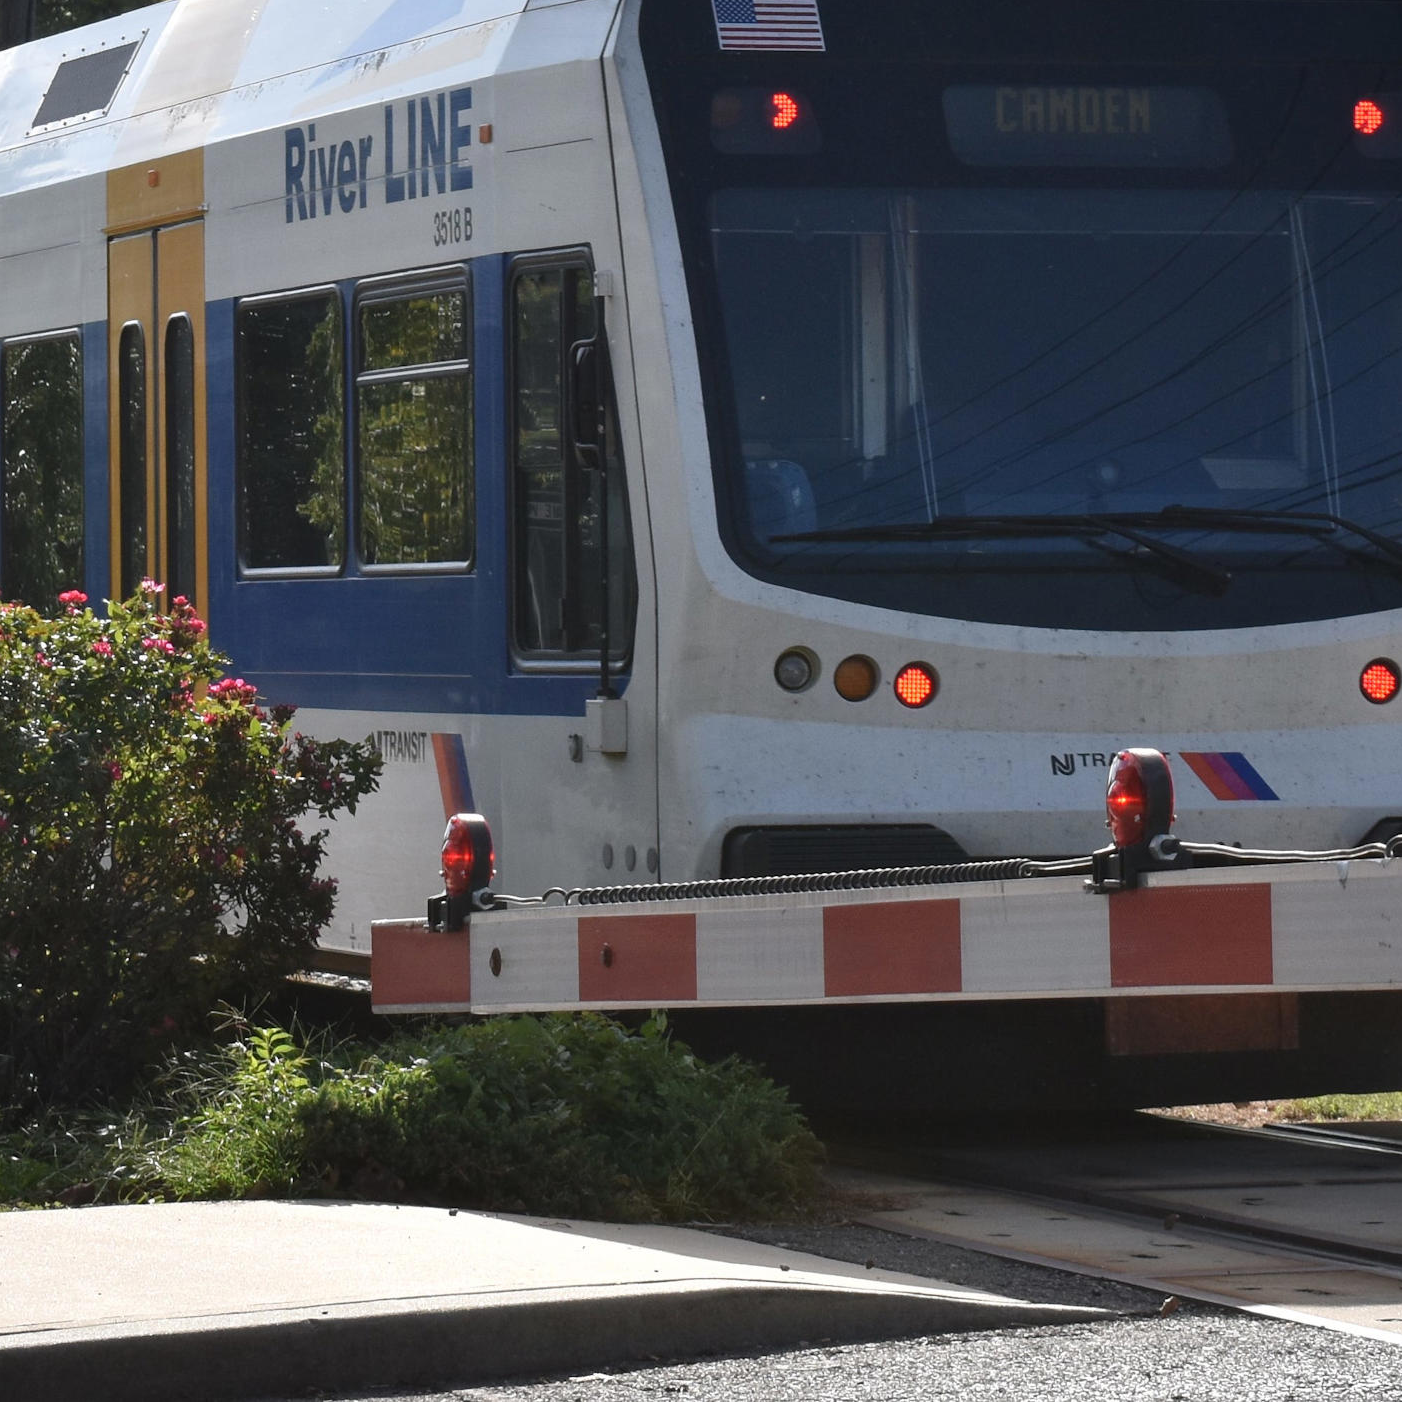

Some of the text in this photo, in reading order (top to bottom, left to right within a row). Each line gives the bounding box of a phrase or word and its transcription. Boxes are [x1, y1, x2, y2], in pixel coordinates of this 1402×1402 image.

[995, 85, 1151, 134] CAMDEN
[284, 86, 474, 224] River LINE
[433, 207, 473, 247] 3518 B
[383, 730, 427, 763] TRANSIT
